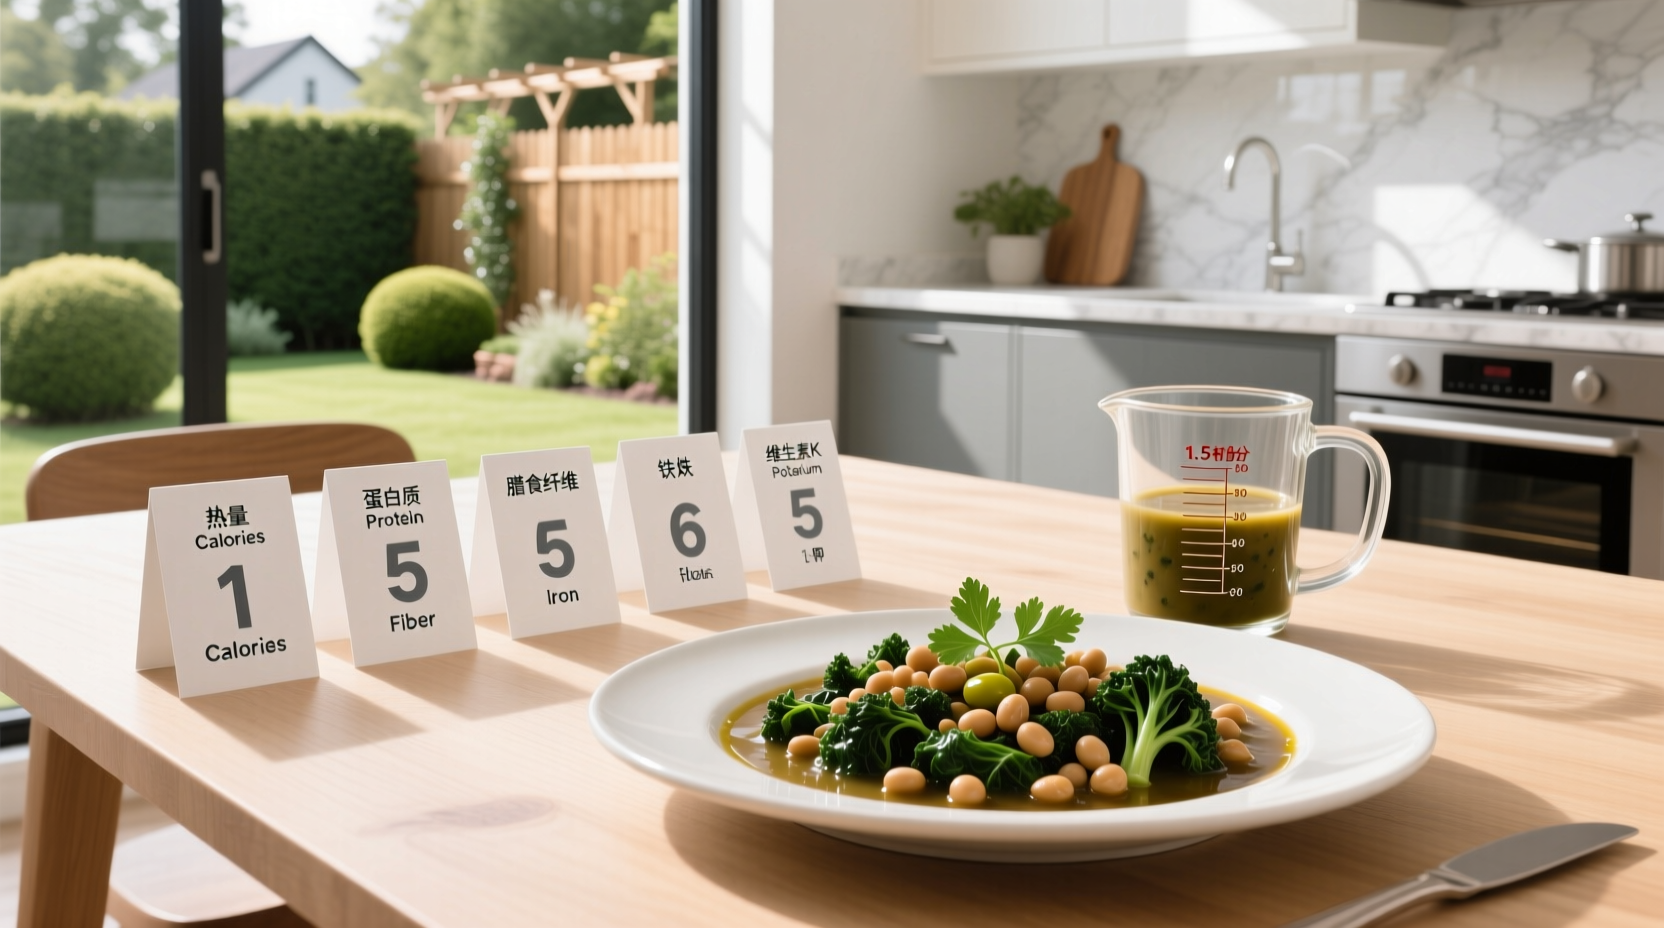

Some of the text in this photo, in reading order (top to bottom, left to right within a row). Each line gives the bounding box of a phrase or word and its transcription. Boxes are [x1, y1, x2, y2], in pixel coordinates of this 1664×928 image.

[362, 485, 421, 510] 蛋白质
[205, 504, 250, 530] 热量
[790, 488, 824, 540] 5
[195, 530, 266, 550] Calories
[669, 502, 707, 558] 6
[536, 518, 576, 579] 5
[385, 540, 429, 603] 5
[216, 564, 253, 630] 1
[546, 589, 580, 606] Iron
[389, 612, 436, 633] Fiber
[204, 636, 287, 663] Calories
